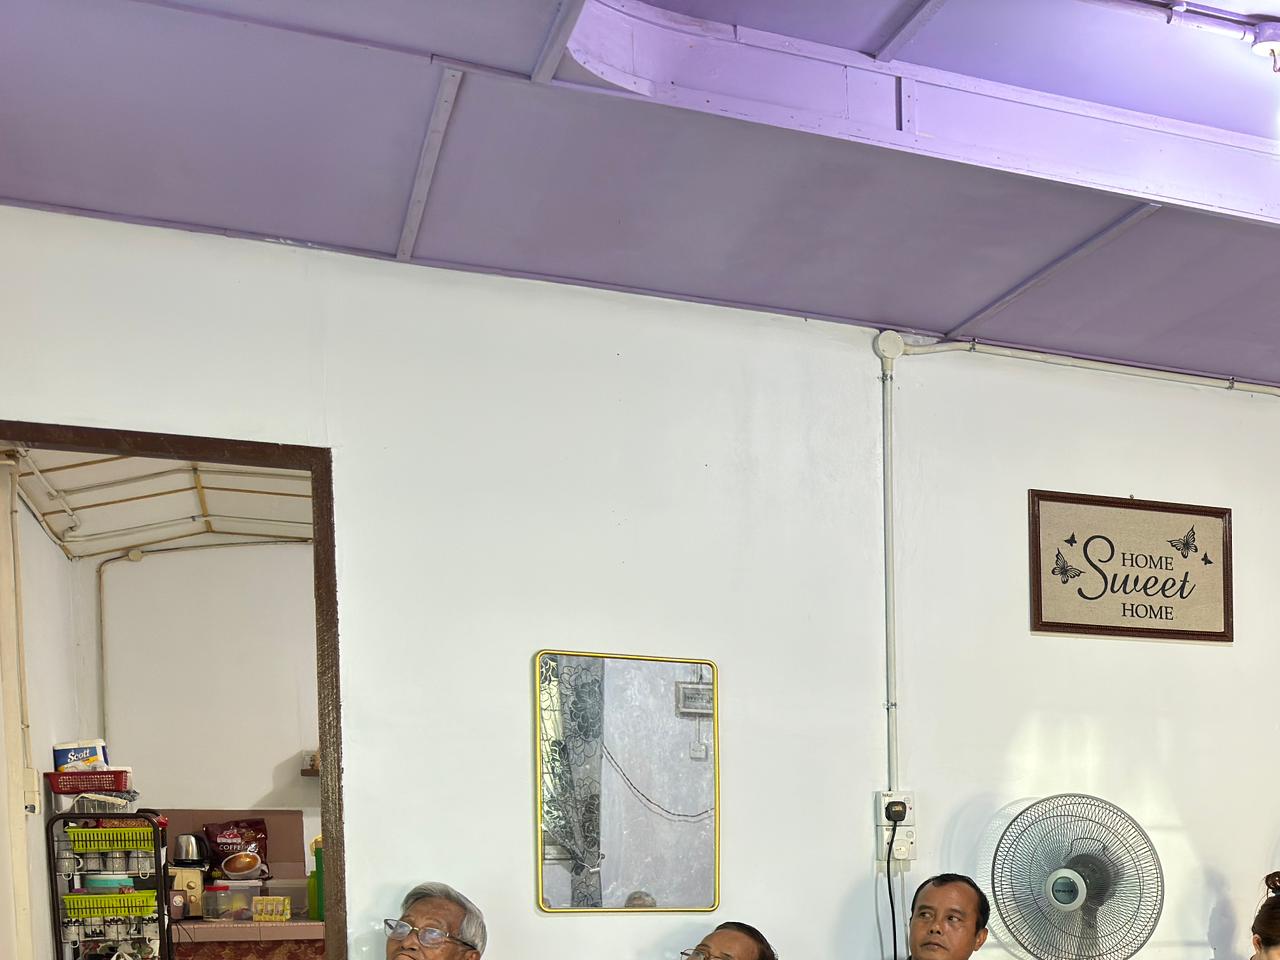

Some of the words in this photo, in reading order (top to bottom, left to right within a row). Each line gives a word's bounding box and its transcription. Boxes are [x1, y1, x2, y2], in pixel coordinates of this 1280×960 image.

[1077, 535, 1196, 601] Sweet
[1121, 552, 1174, 571] HOME
[1121, 602, 1174, 621] HOME
[67, 748, 90, 763] Scott
